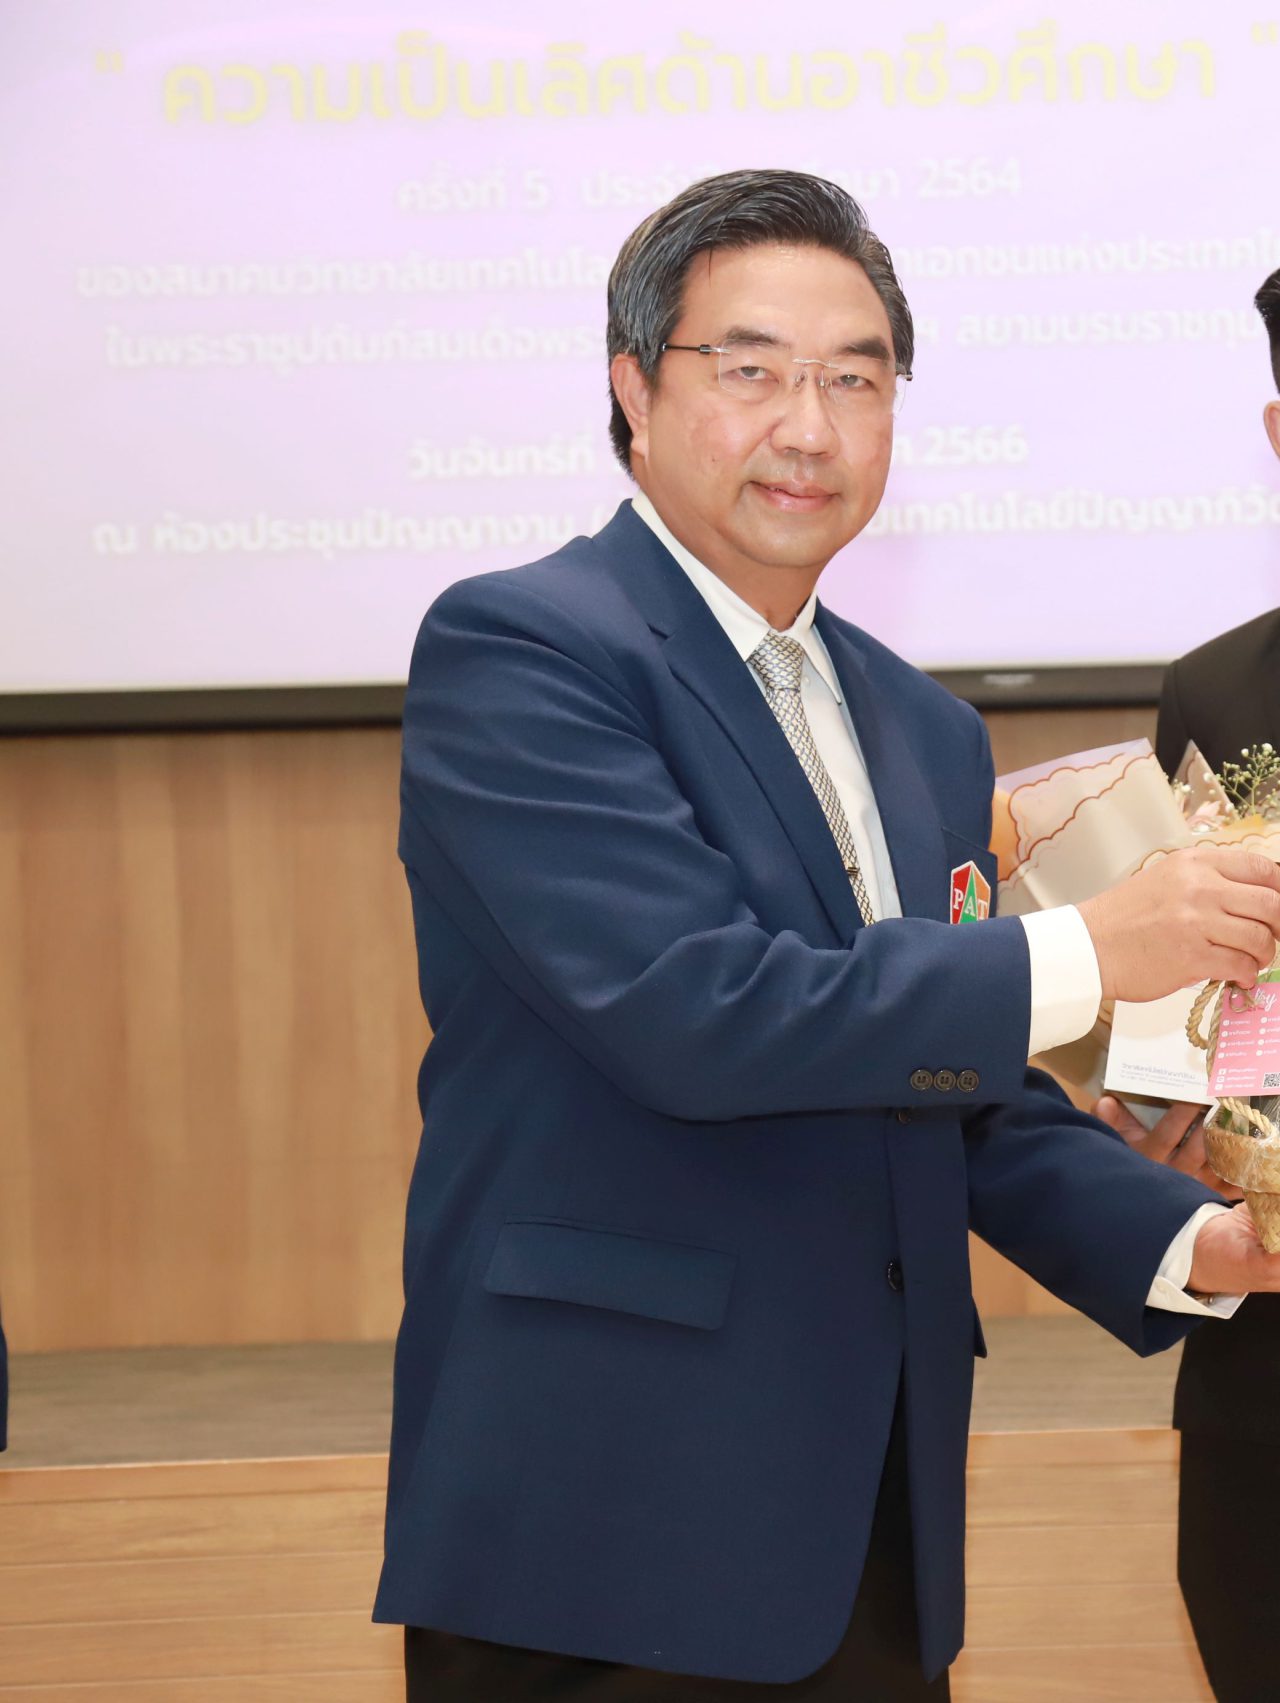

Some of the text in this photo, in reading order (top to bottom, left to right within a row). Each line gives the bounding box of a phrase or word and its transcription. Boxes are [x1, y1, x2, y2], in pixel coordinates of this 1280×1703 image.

[162, 19, 1217, 125] ความเป็นเลิศด้านอาชีวศึกษา
[523, 168, 550, 209] 5
[916, 156, 1022, 199] 2564
[76, 246, 612, 298] ของสมาคมวิทยาลัยเทคโนโล
[953, 888, 988, 921] PAT
